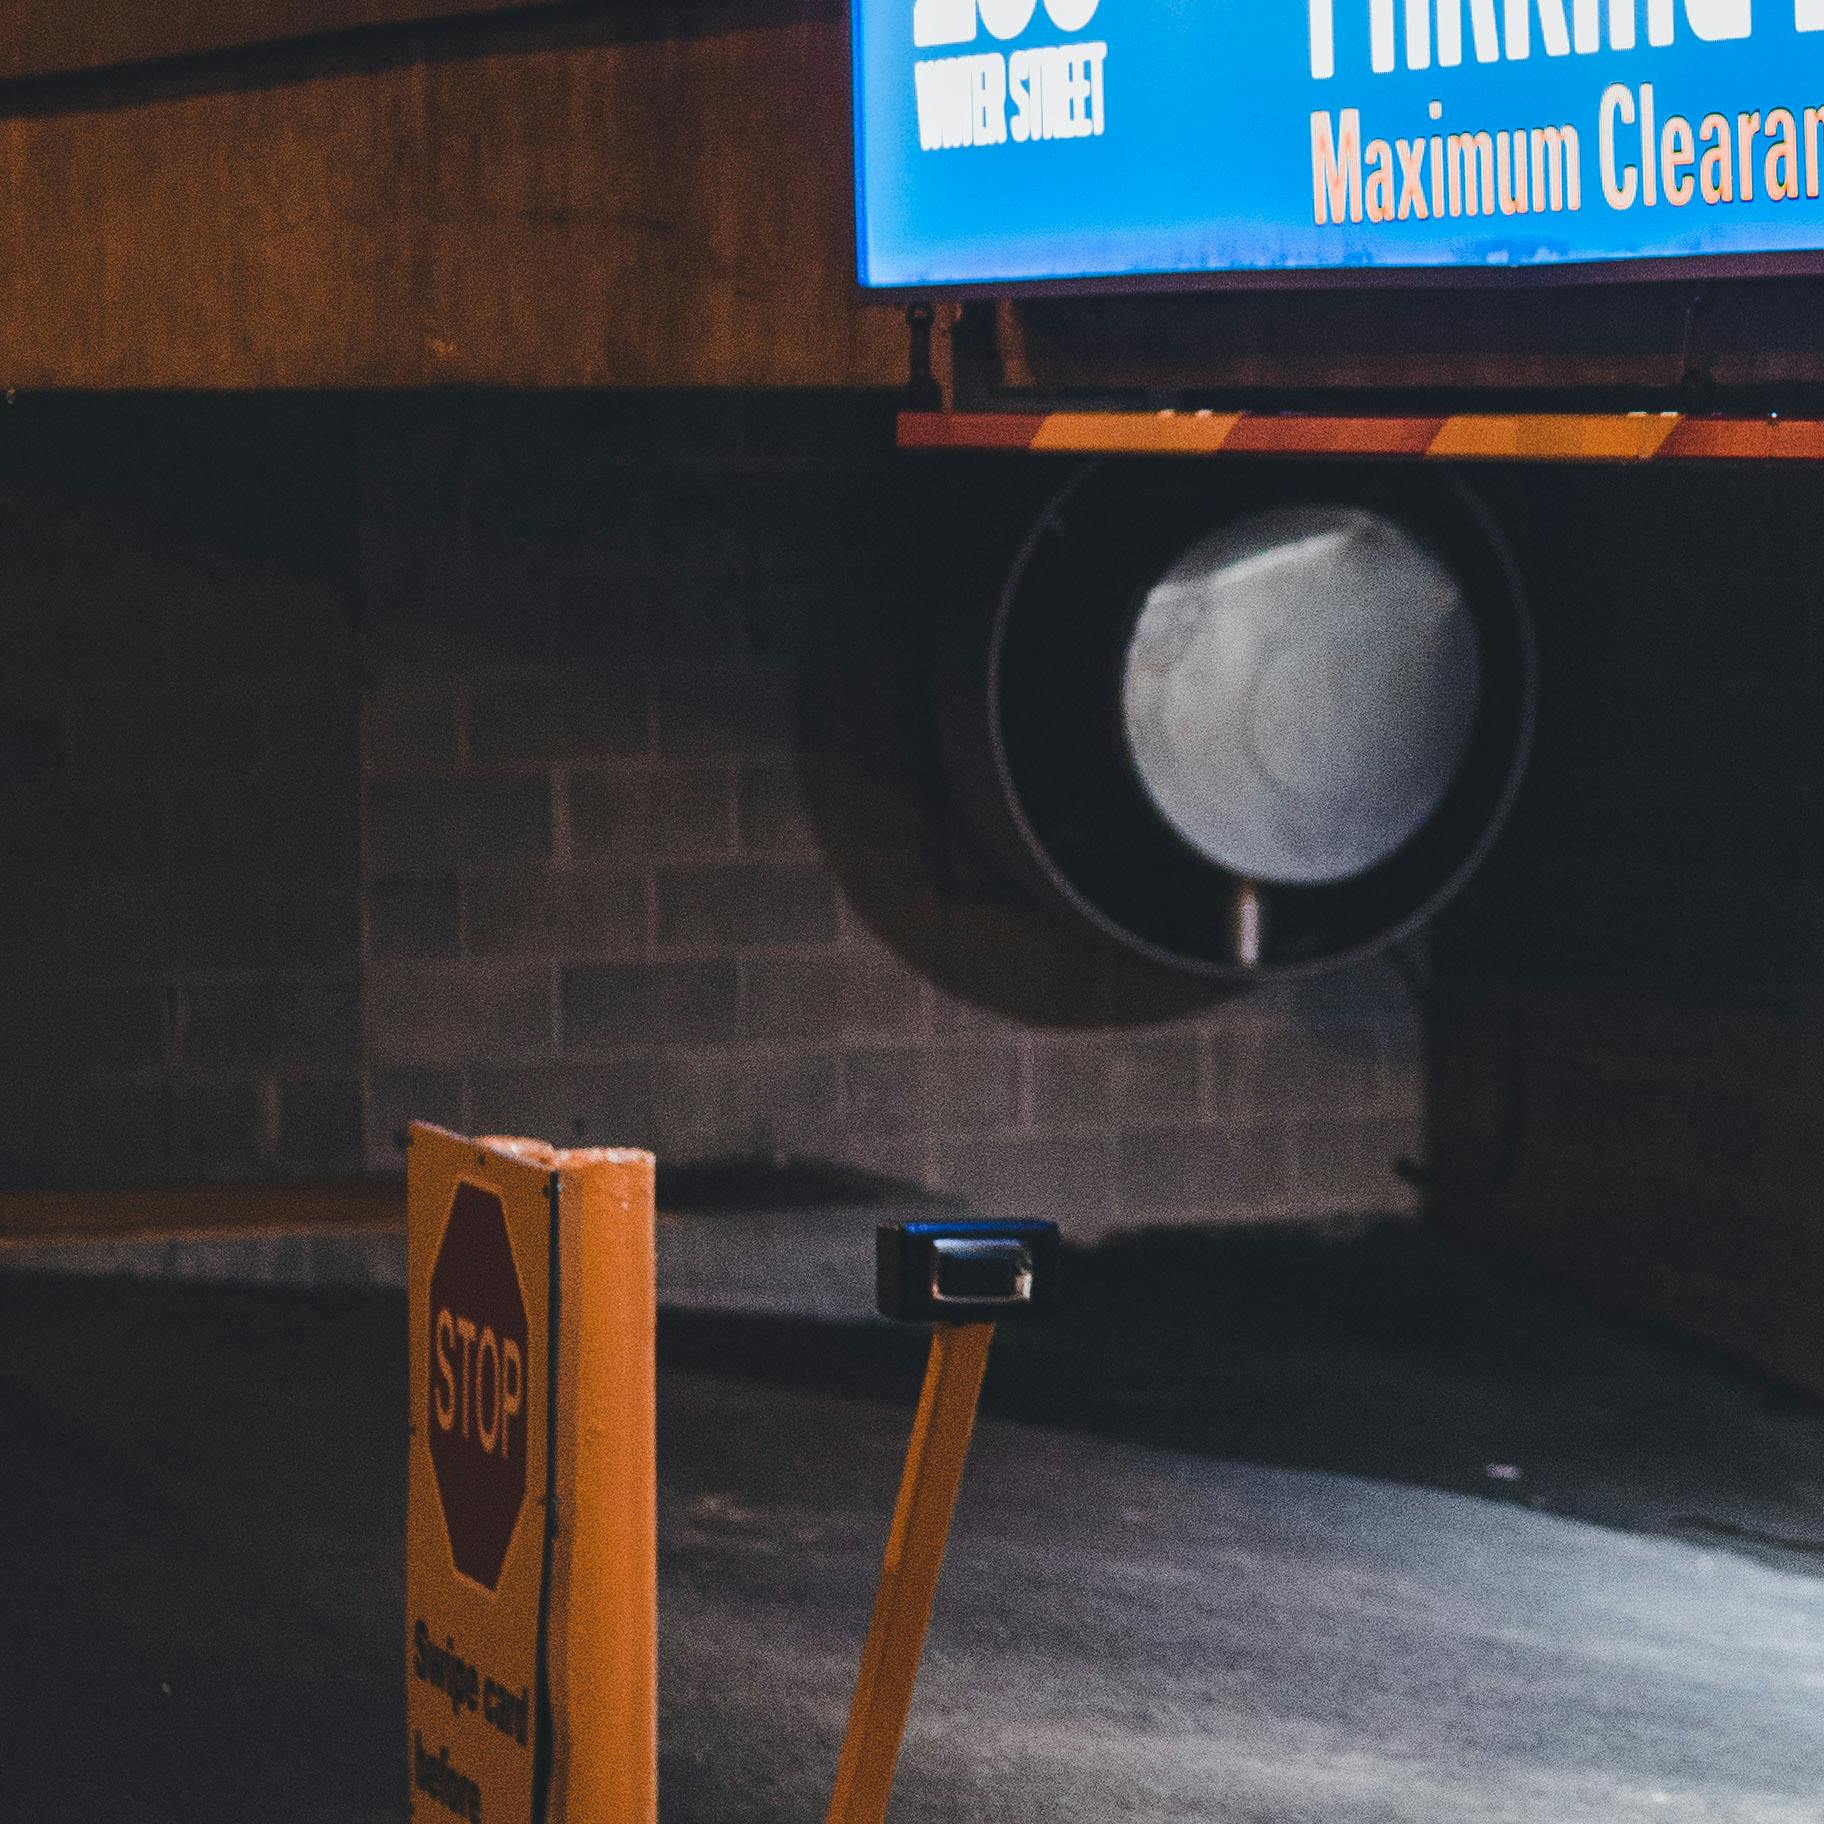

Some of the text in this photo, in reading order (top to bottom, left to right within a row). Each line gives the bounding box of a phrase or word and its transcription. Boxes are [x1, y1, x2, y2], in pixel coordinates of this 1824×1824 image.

[1009, 41, 1107, 142] STREET
[1309, 99, 1581, 225] Maximum
[435, 1304, 524, 1459] STOP
